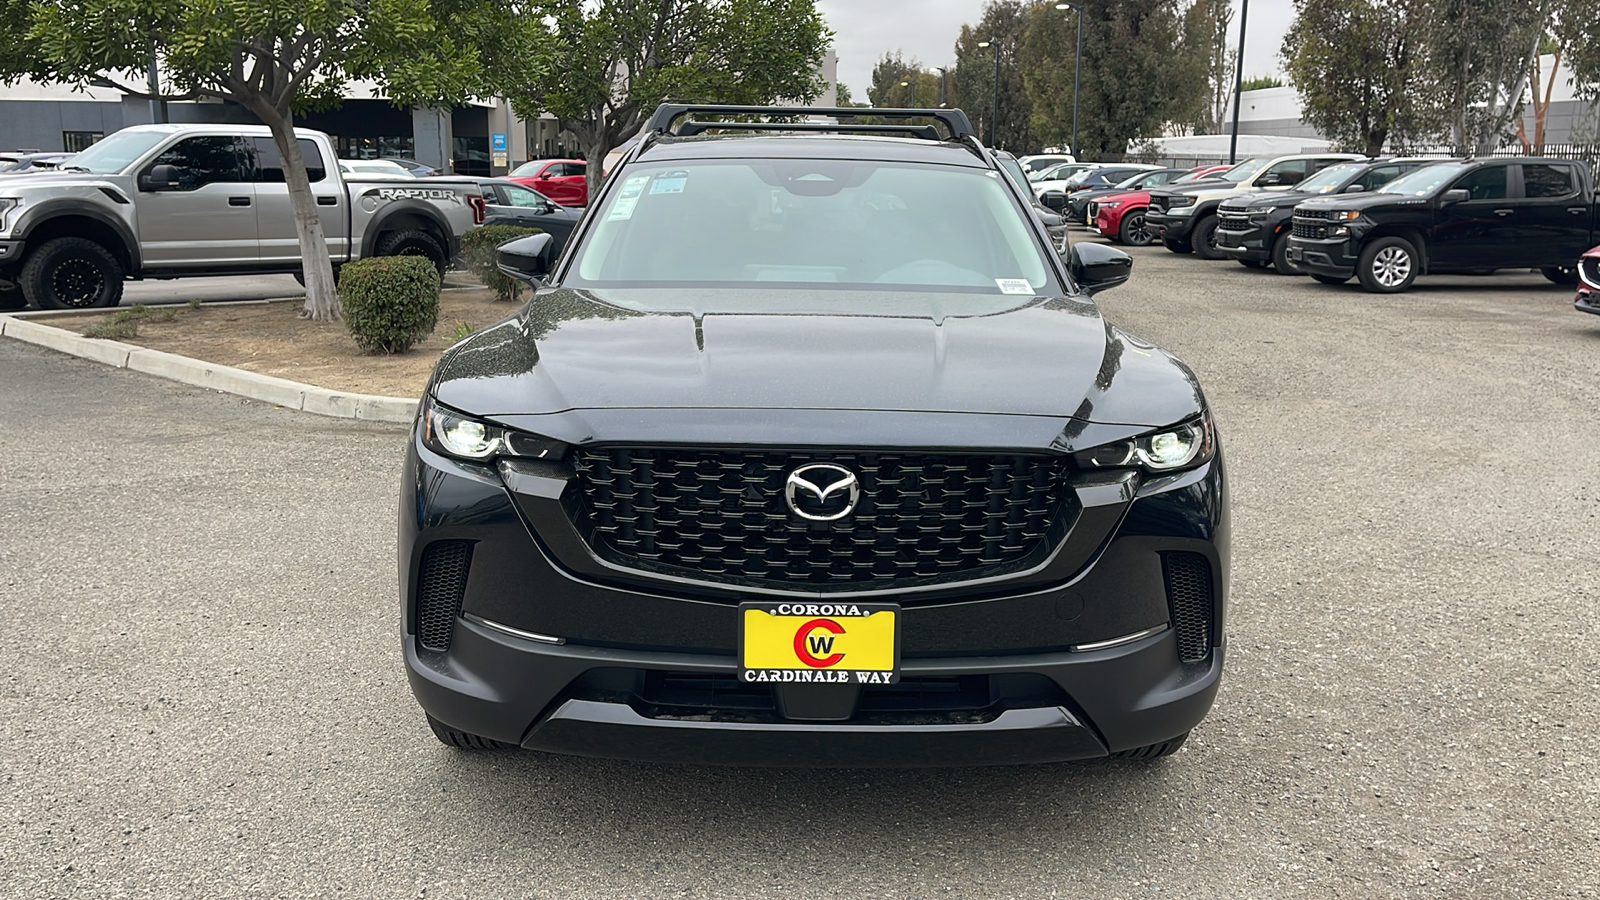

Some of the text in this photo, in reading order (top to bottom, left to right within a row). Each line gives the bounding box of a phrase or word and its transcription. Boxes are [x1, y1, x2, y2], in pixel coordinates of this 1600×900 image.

[379, 188, 460, 205] RAPTOR
[778, 604, 862, 616] CORONA
[744, 670, 893, 684] CARDINALE WAY
